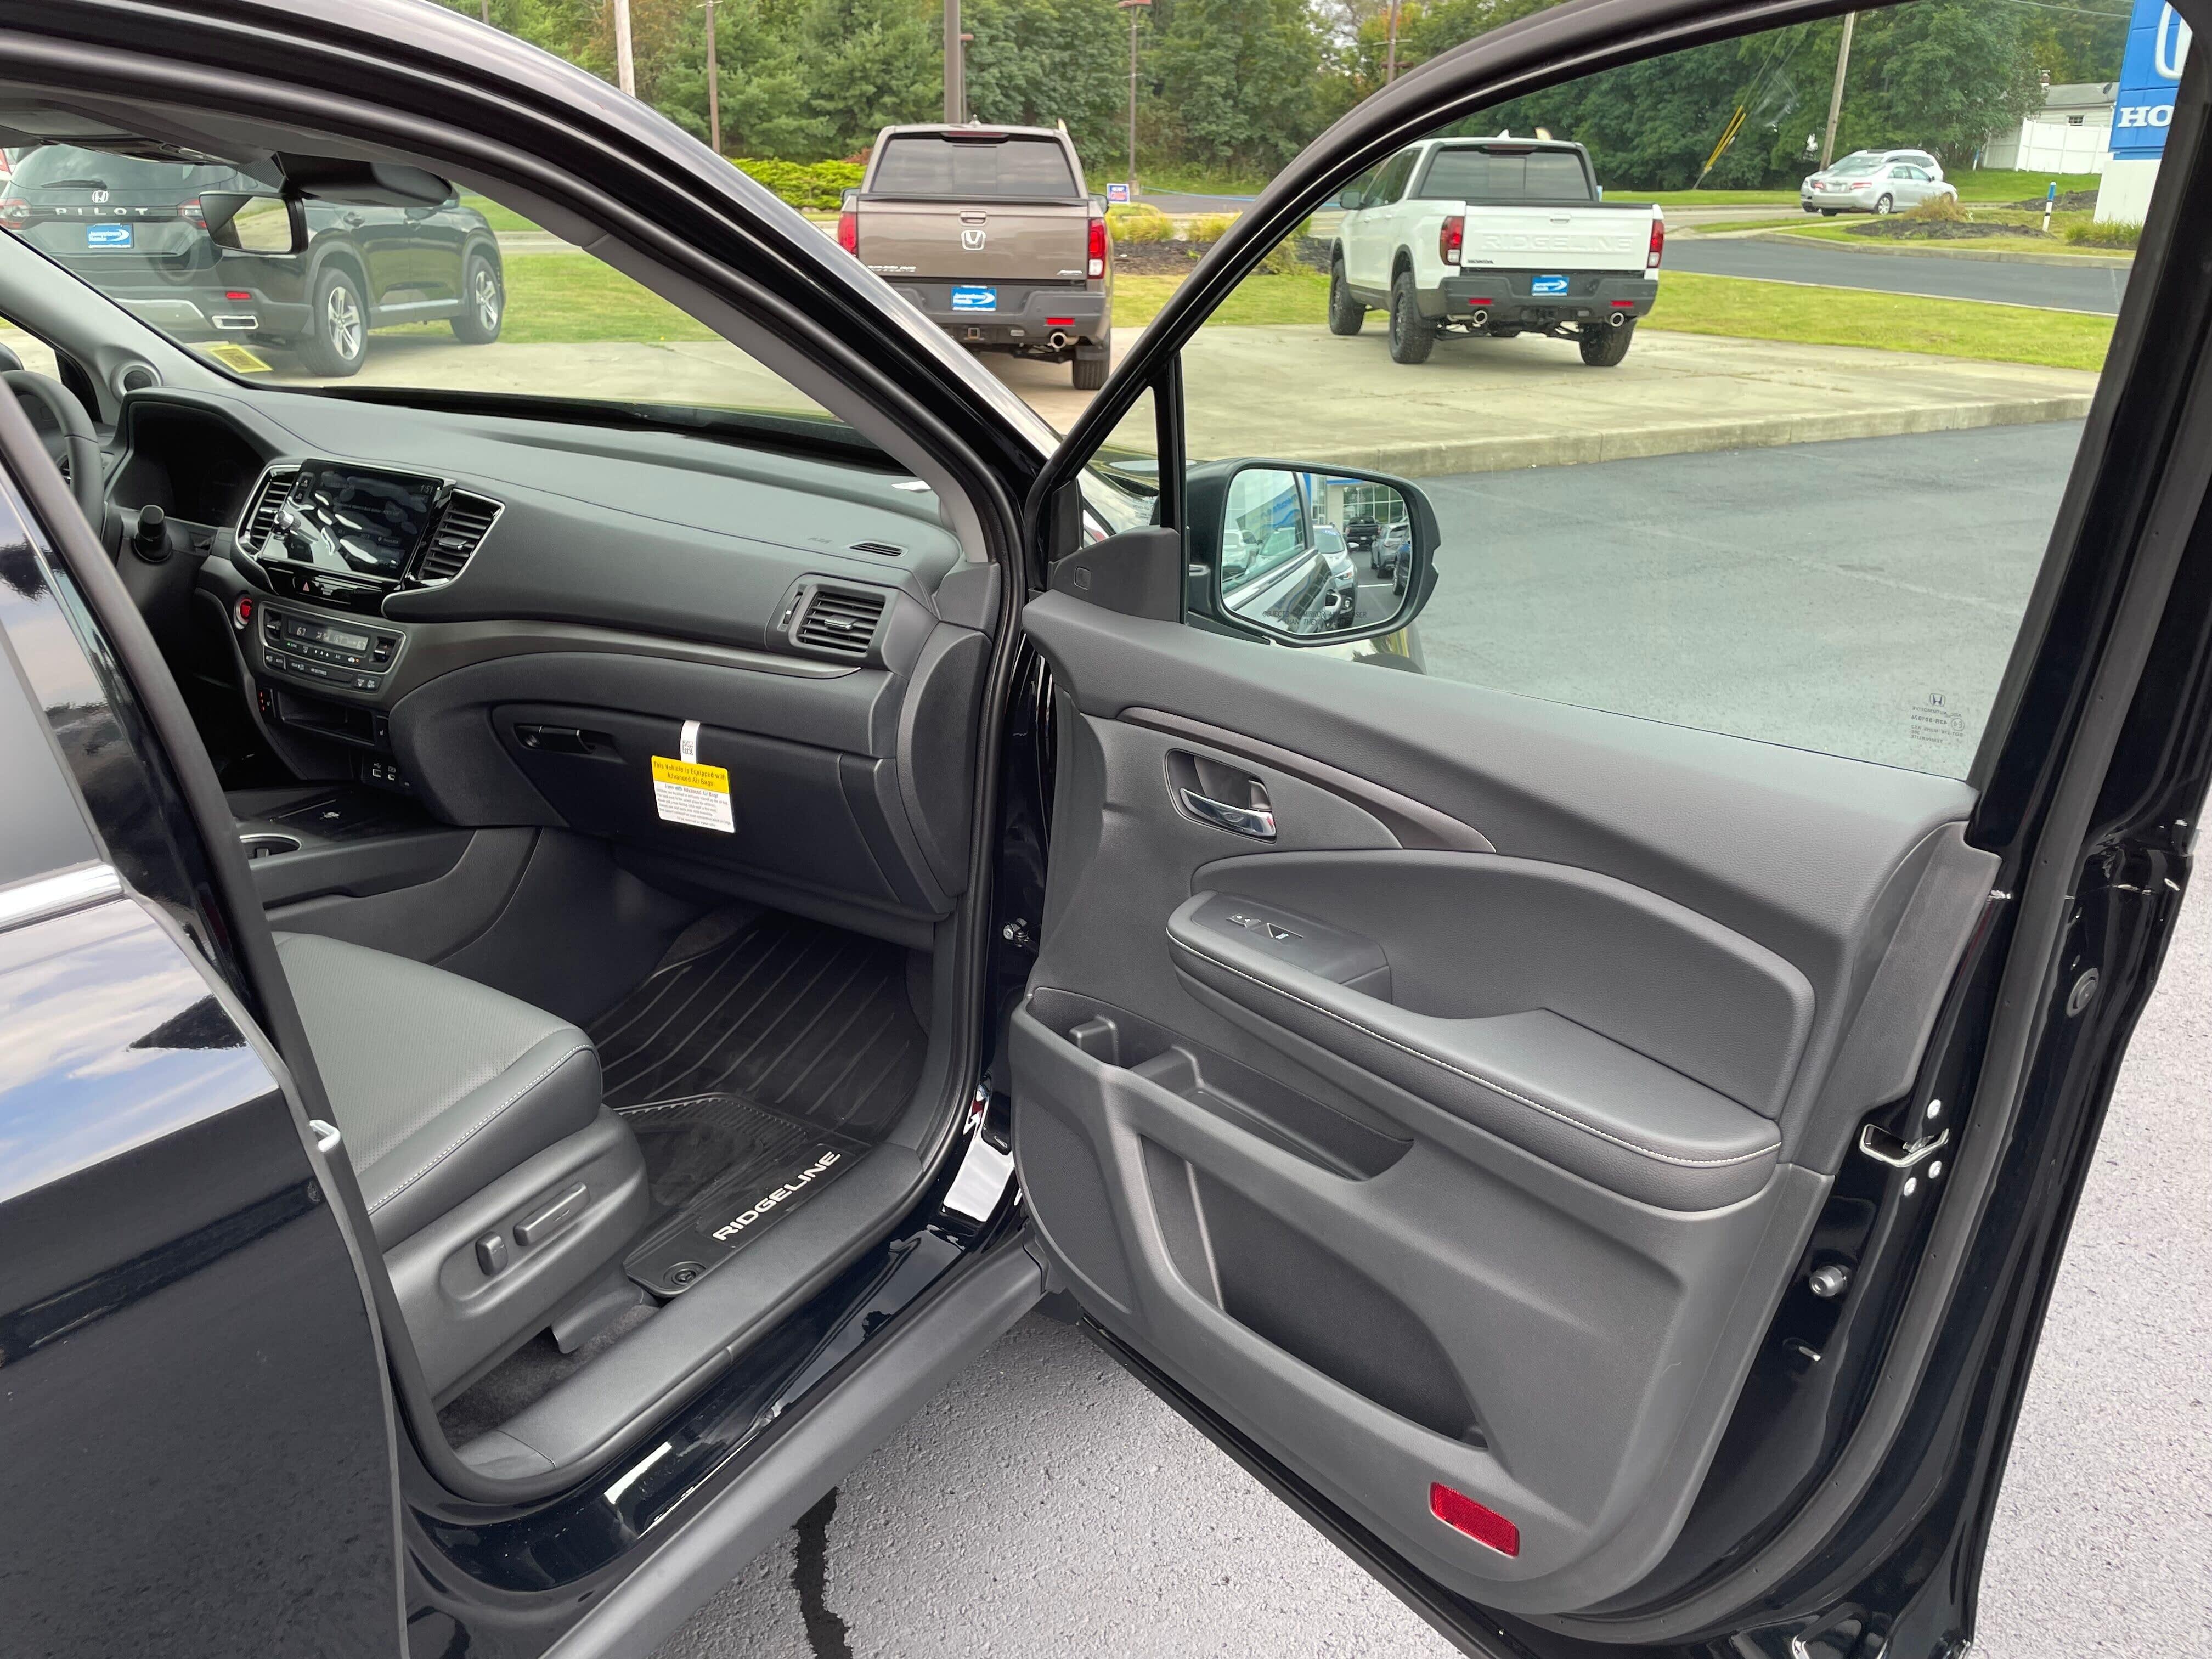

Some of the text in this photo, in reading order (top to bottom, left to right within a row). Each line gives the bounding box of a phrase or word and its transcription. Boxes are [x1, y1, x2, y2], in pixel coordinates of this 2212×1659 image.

[55, 207, 148, 216] PILOT
[296, 627, 307, 636] 67
[665, 764, 684, 773] Vehicle
[691, 768, 714, 778] Equipped
[667, 772, 691, 782] Advanced
[712, 1150, 842, 1241] RIDGELINE
